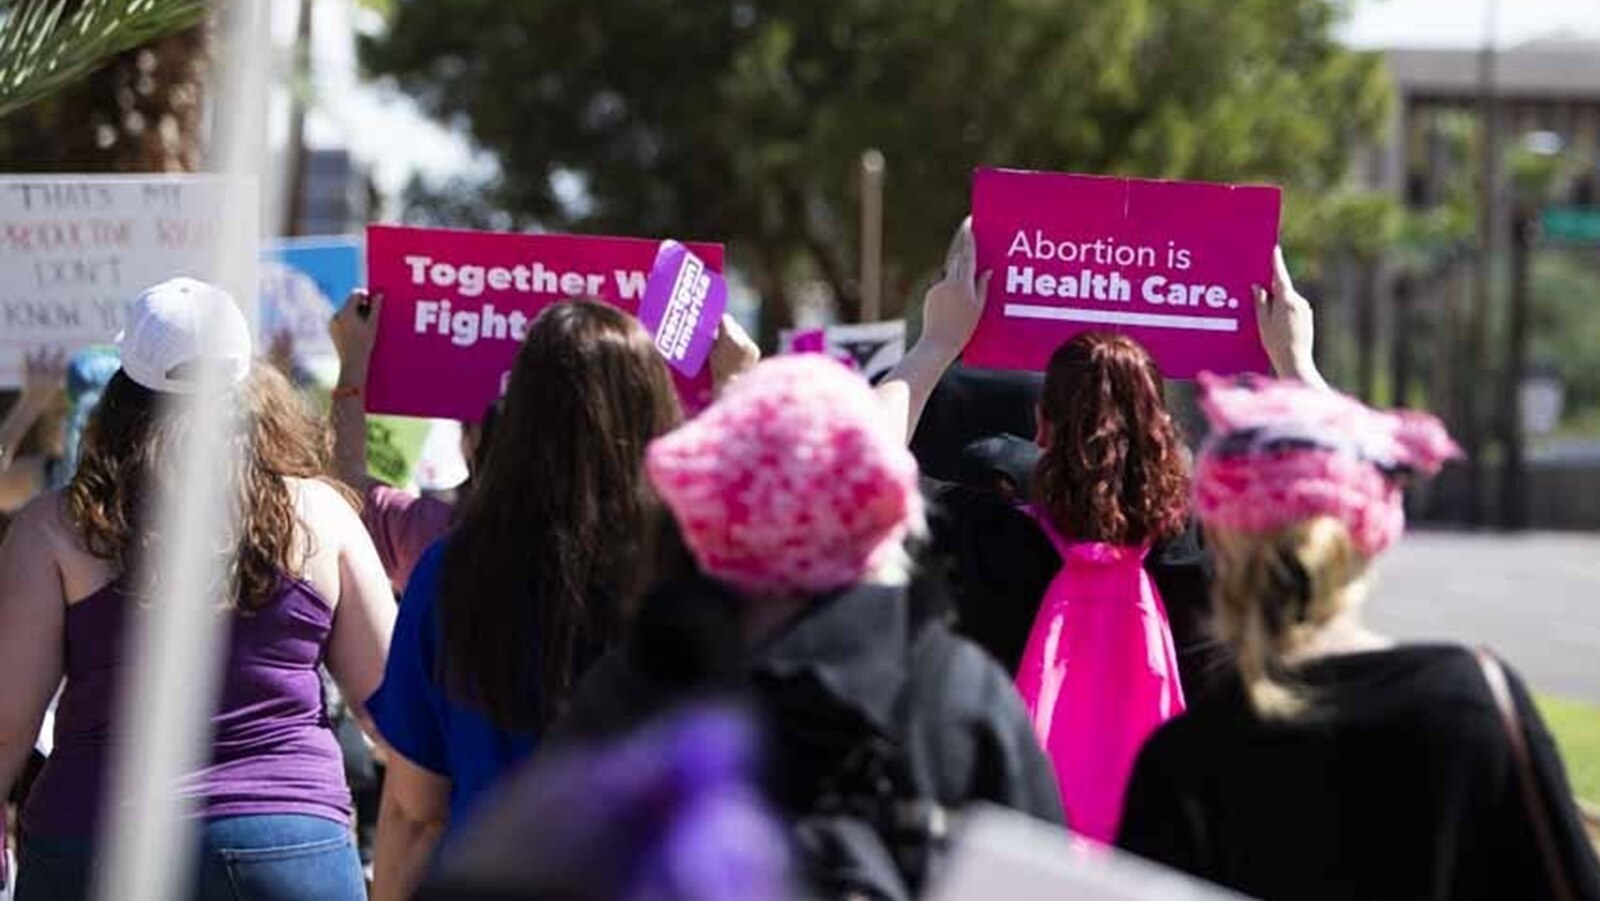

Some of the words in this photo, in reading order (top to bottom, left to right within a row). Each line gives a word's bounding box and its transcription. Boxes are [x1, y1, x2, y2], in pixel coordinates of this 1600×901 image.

[0, 219, 135, 249] RODUCTIVE
[1008, 230, 1155, 267] Abortion
[1167, 242, 1191, 269] is
[405, 256, 605, 297] Together
[614, 269, 647, 299] W
[1005, 265, 1131, 302] Health
[1142, 276, 1239, 309] Care.
[415, 298, 527, 346] Fight
[659, 261, 700, 353] nextgen
[675, 274, 712, 361] america
